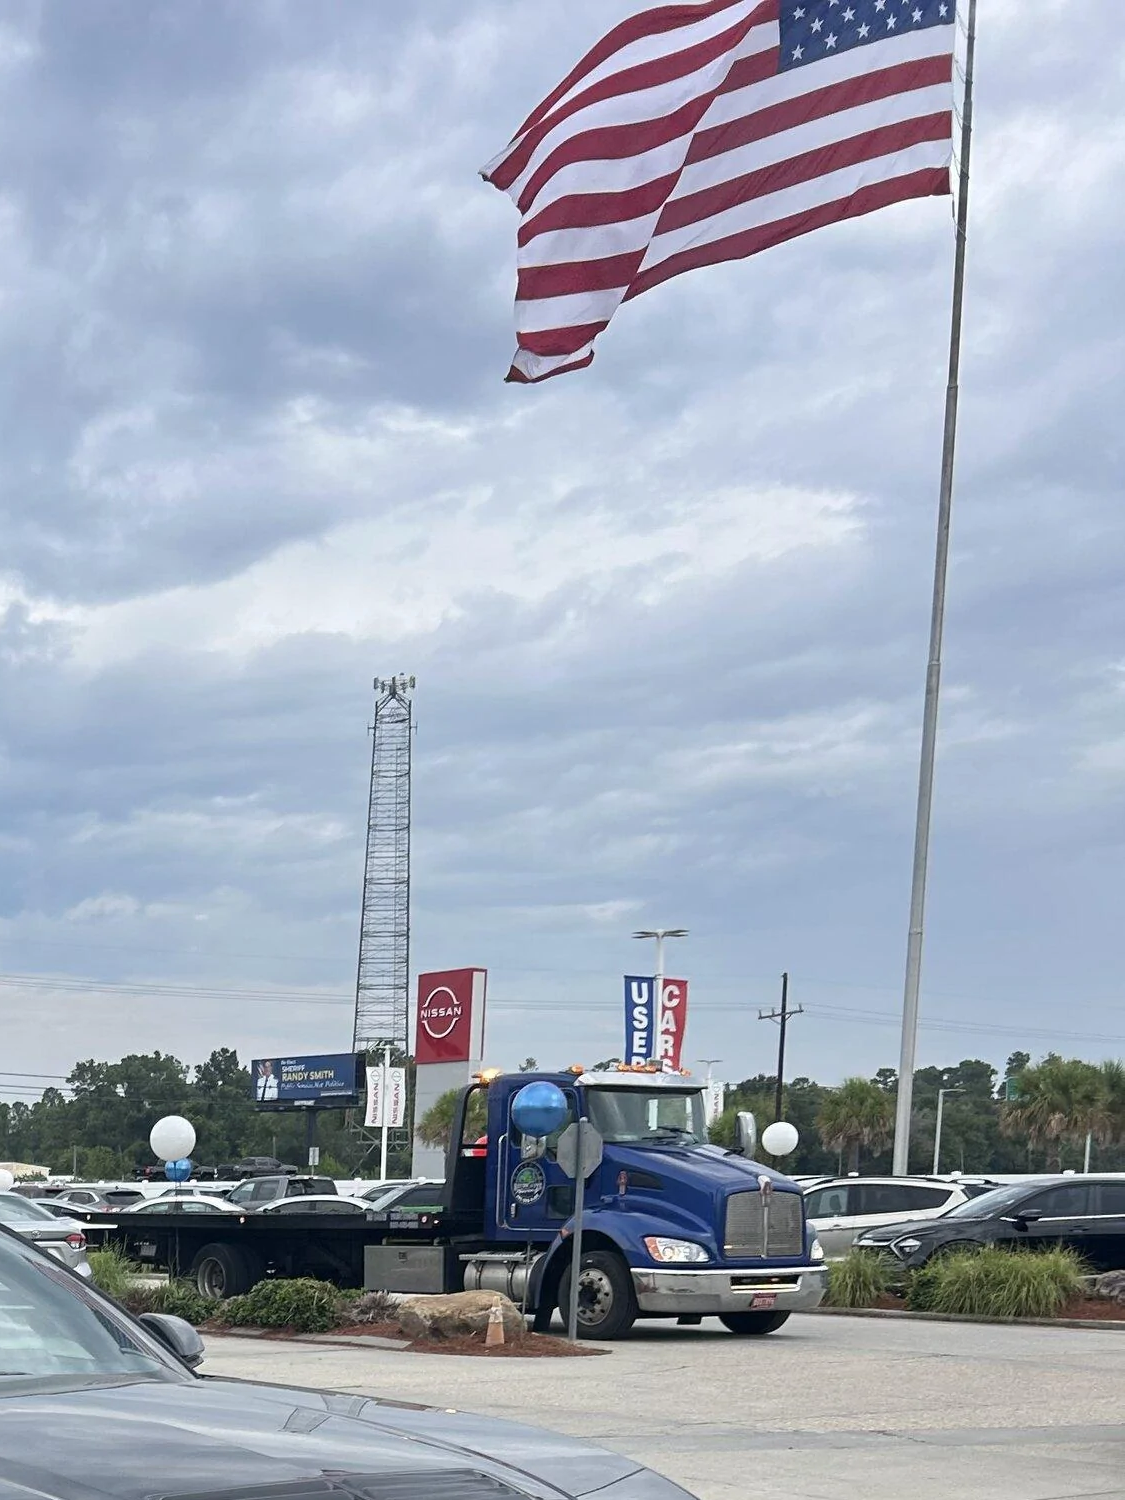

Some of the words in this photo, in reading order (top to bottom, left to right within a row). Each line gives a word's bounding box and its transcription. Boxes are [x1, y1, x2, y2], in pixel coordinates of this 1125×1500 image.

[420, 1006, 462, 1019] NISSAN
[282, 1072, 308, 1082] RANDY
[309, 1070, 334, 1080] SMITH
[371, 1082, 379, 1124] NISSAN
[391, 1083, 400, 1125] NISSAN
